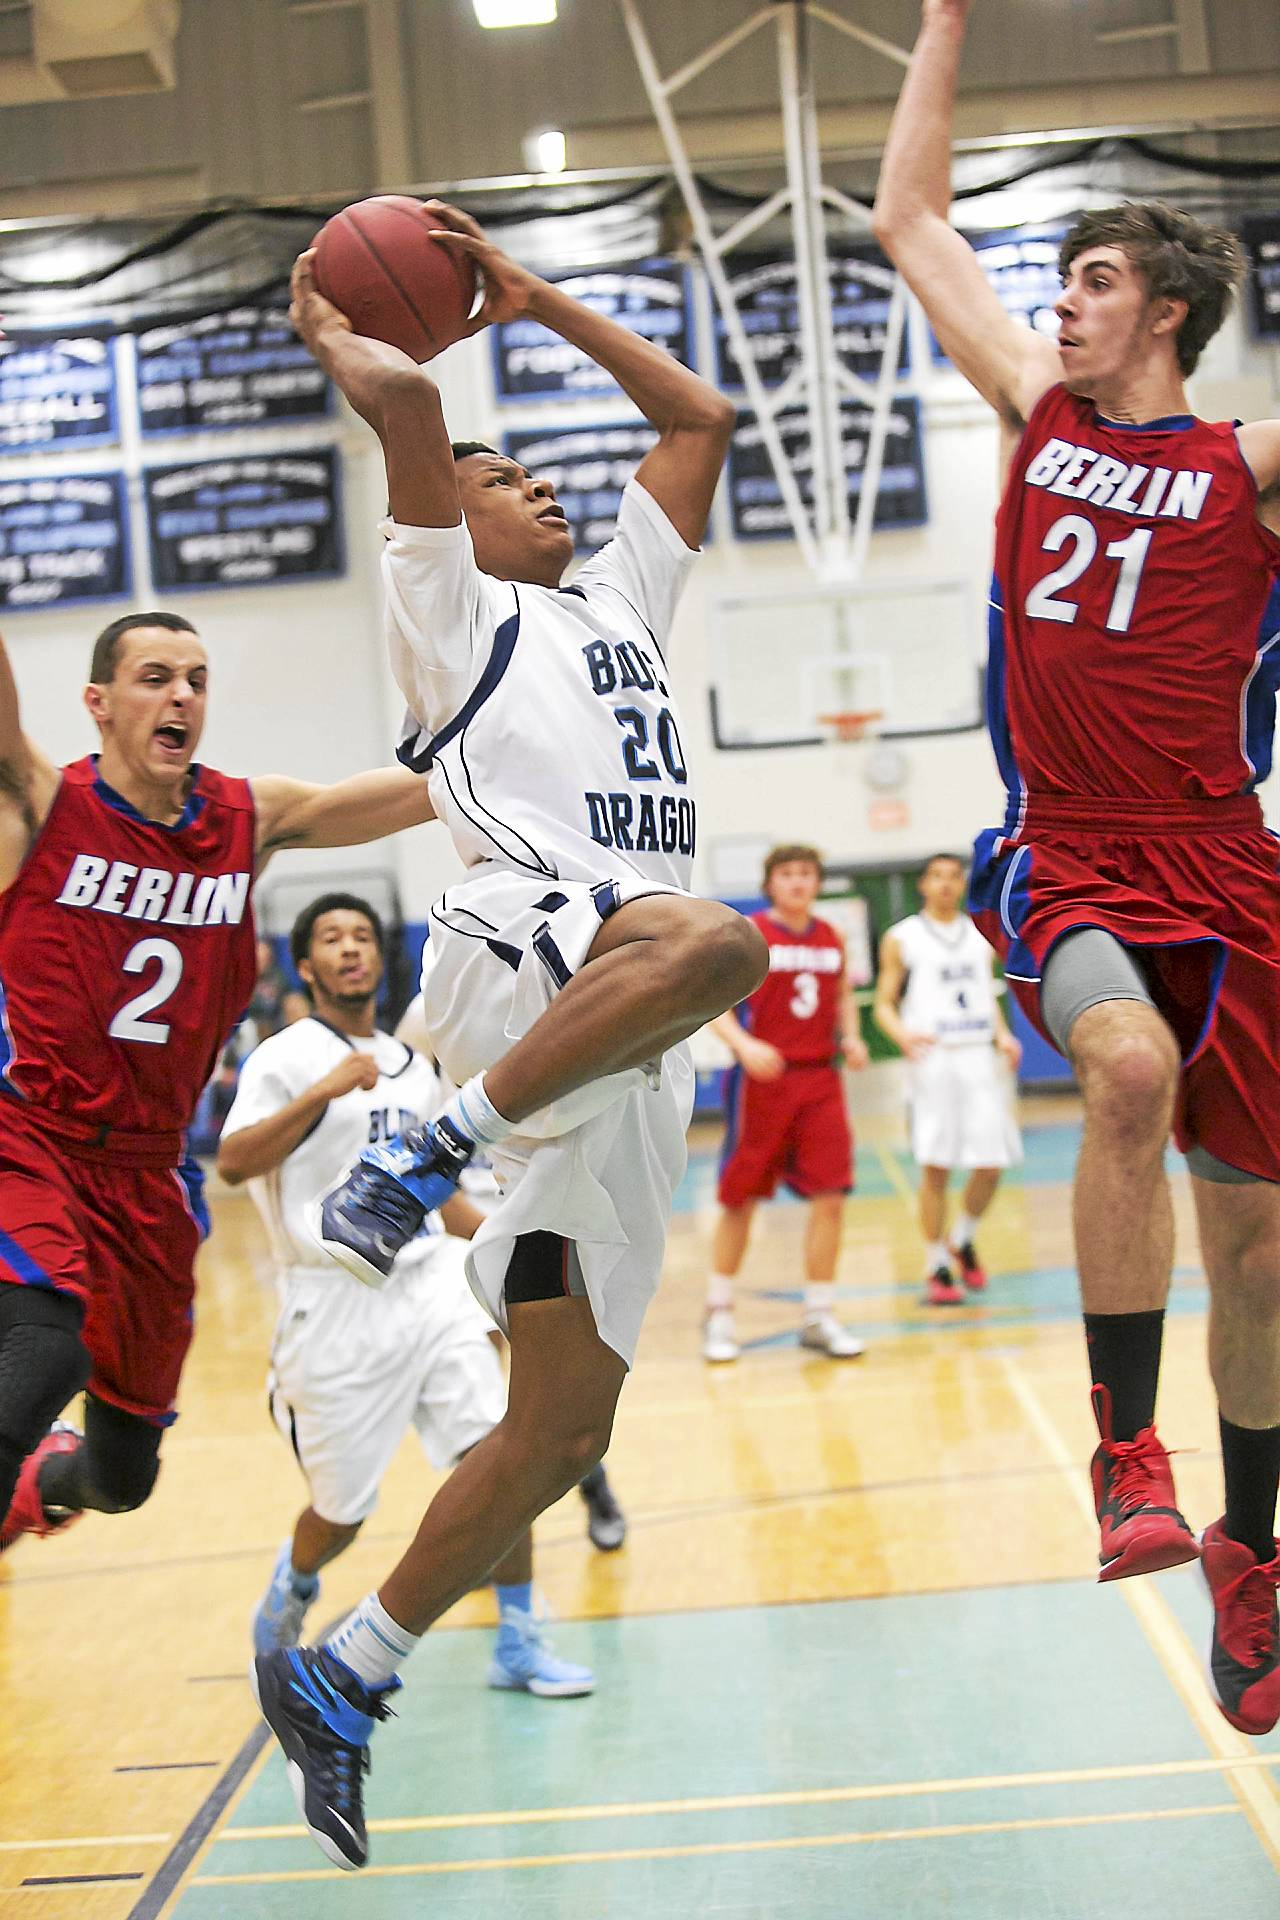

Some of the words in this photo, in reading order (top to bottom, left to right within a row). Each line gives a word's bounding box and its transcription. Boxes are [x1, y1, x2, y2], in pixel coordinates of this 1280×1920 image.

[1024, 437, 1214, 520] BERLIN
[1025, 514, 1153, 632] 21
[614, 706, 687, 784] 20
[585, 792, 696, 858] DRAGO
[55, 854, 250, 926] BERLIN
[109, 938, 183, 1044] 2
[790, 972, 819, 1019] 3
